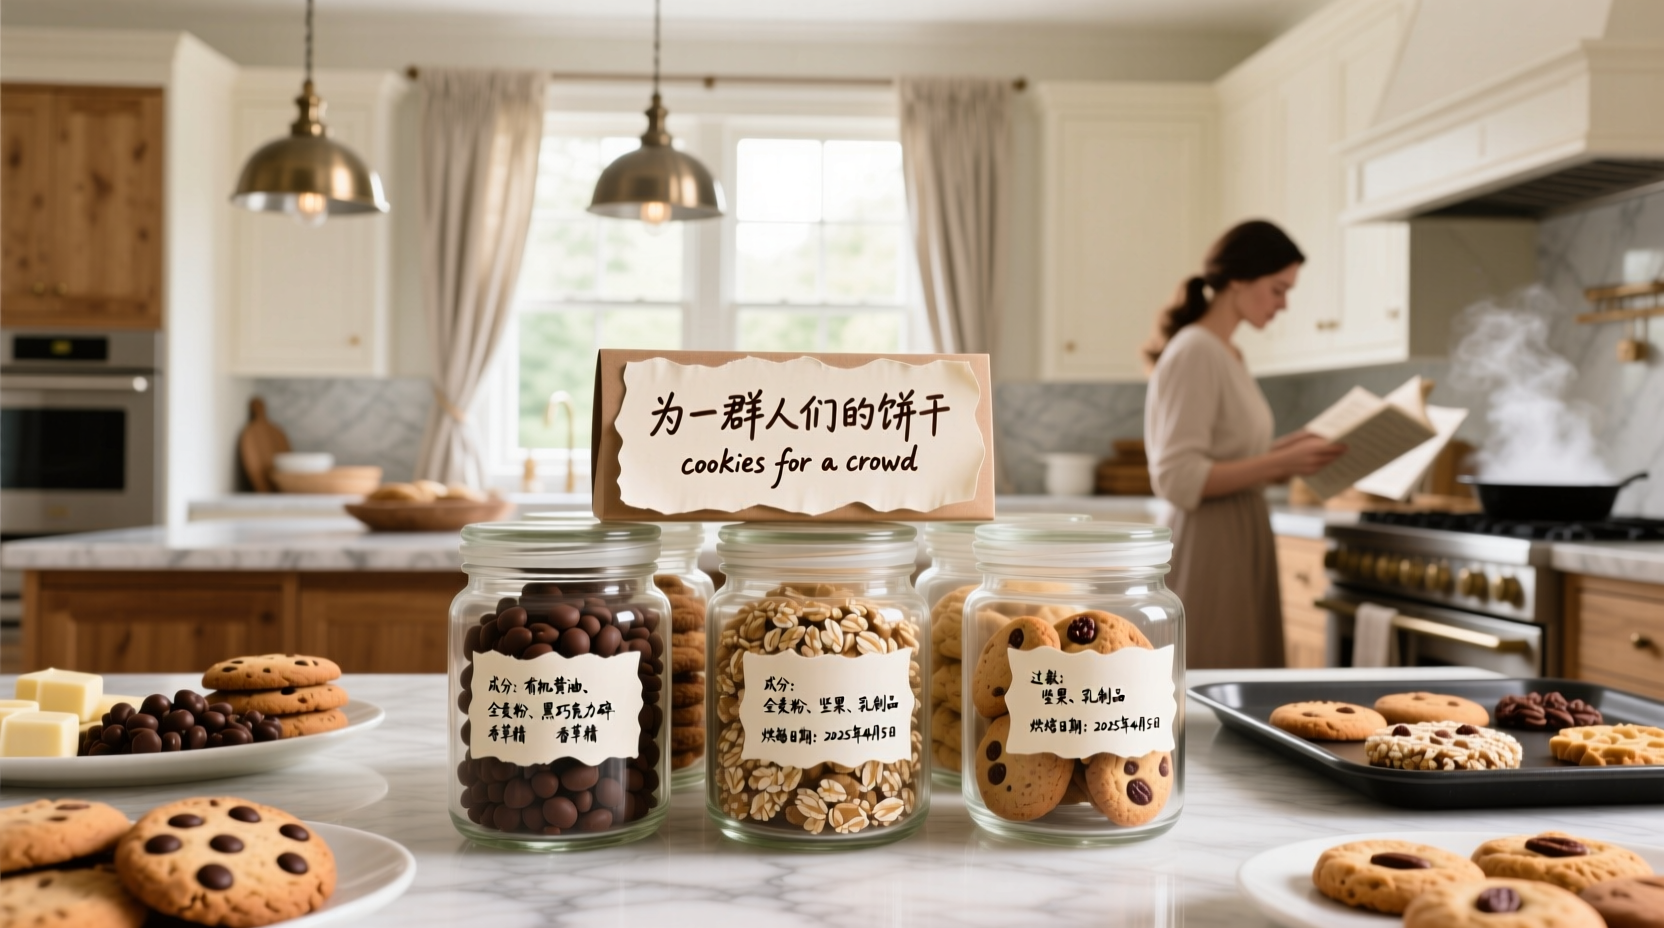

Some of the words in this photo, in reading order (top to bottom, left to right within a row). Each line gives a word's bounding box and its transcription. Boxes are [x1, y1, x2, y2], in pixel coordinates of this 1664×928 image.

[649, 388, 951, 442] 为一群人们的饼干
[681, 447, 766, 476] cookies
[770, 446, 813, 490] for
[821, 457, 839, 472] a
[846, 444, 918, 472] crowd
